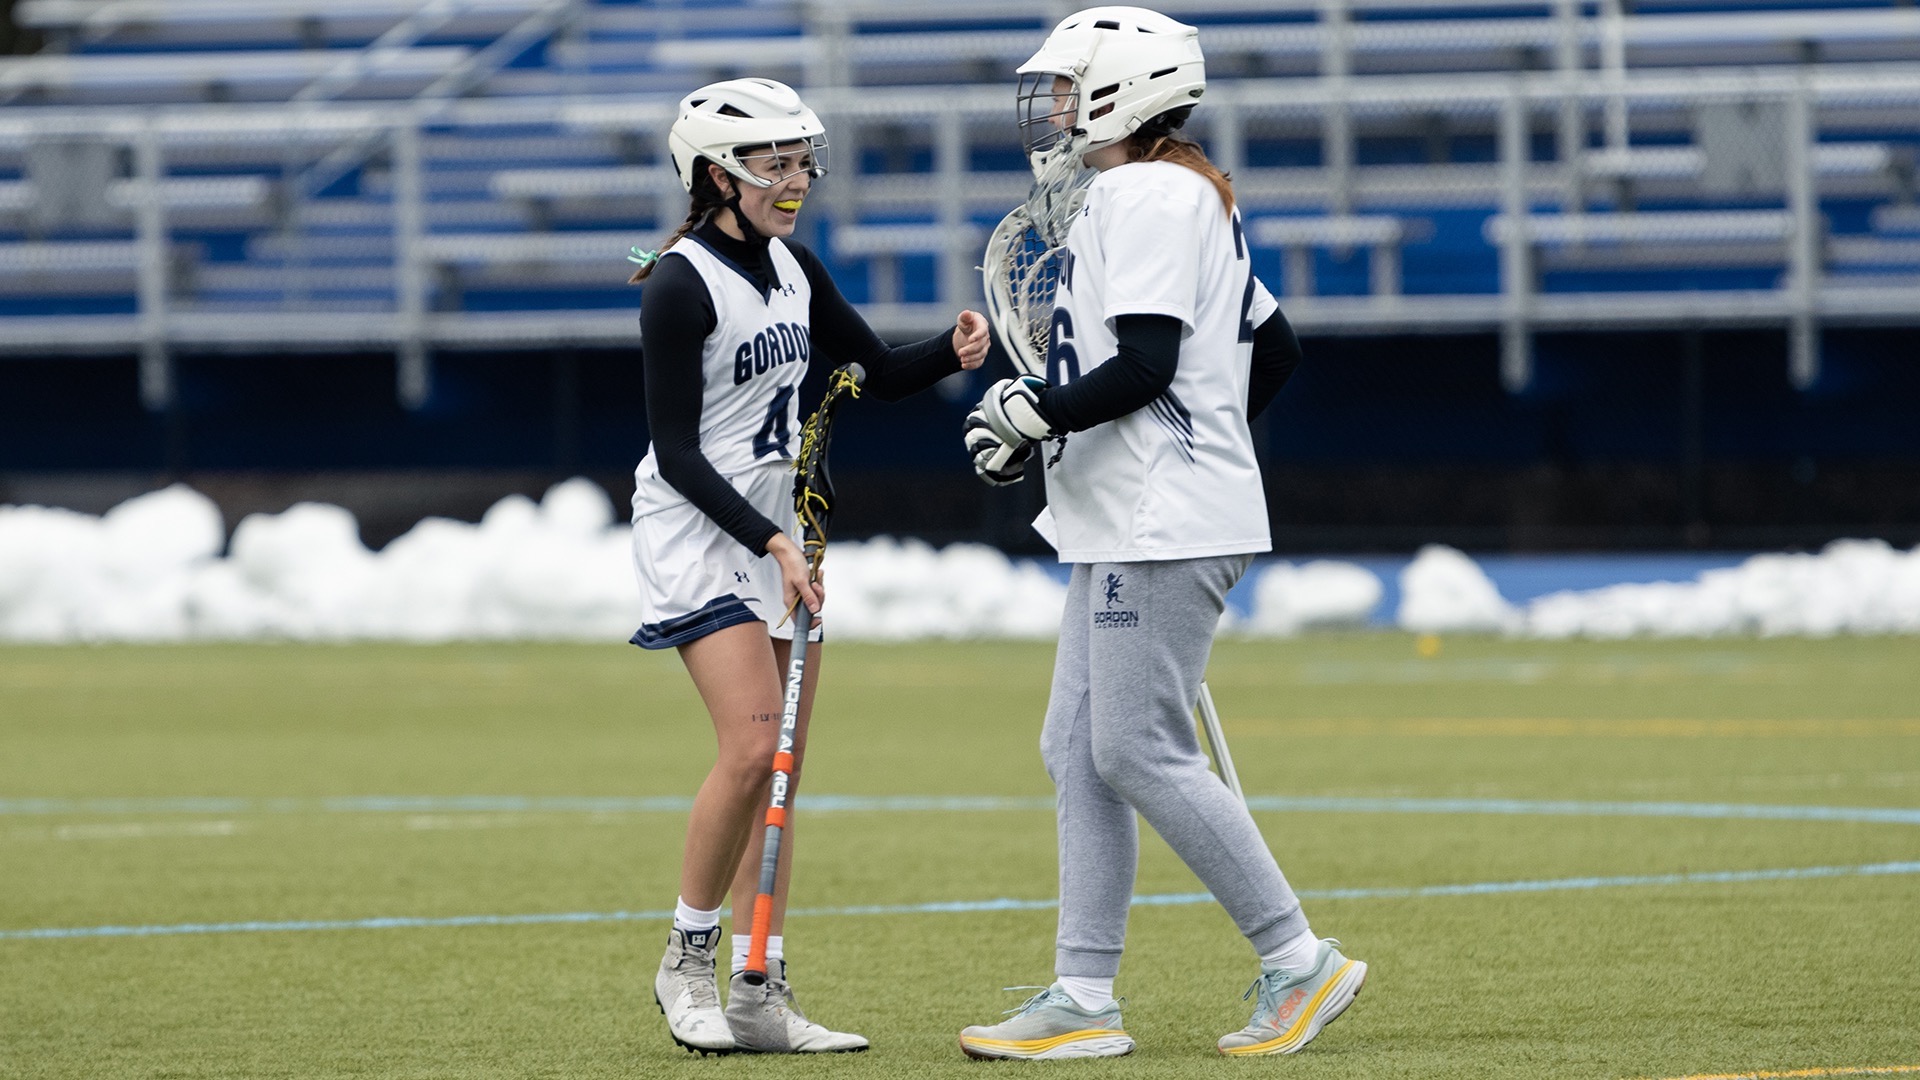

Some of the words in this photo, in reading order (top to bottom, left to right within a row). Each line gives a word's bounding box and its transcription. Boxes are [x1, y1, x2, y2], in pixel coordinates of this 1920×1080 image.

[734, 322, 810, 386] GORDO
[752, 383, 796, 460] 4
[1094, 610, 1139, 624] GORDON
[783, 659, 804, 730] UNDER
